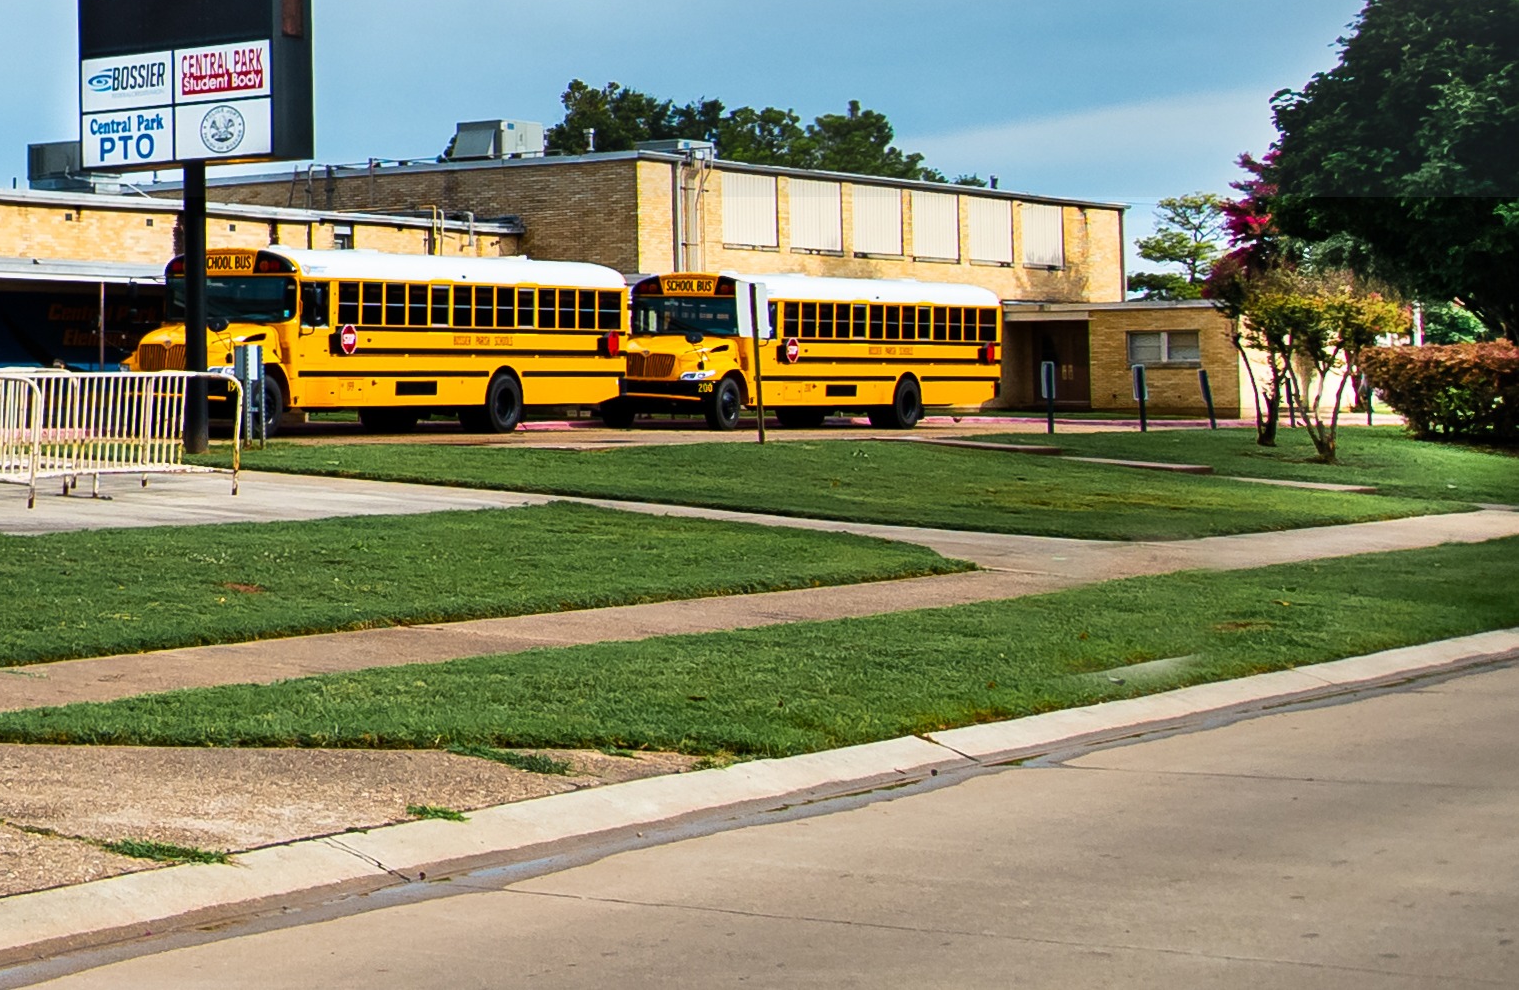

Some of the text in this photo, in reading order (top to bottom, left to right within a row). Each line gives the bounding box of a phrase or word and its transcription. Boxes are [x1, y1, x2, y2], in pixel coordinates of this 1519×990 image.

[182, 47, 262, 77] CENTRAL PARK
[112, 62, 165, 91] BOSSIER
[183, 71, 261, 92] Student Body
[90, 113, 164, 135] Central Park
[100, 133, 154, 162] PTO
[206, 255, 251, 270] CHOOL BUS
[666, 280, 712, 292] SCHOOL BUS
[698, 383, 713, 392] 200
